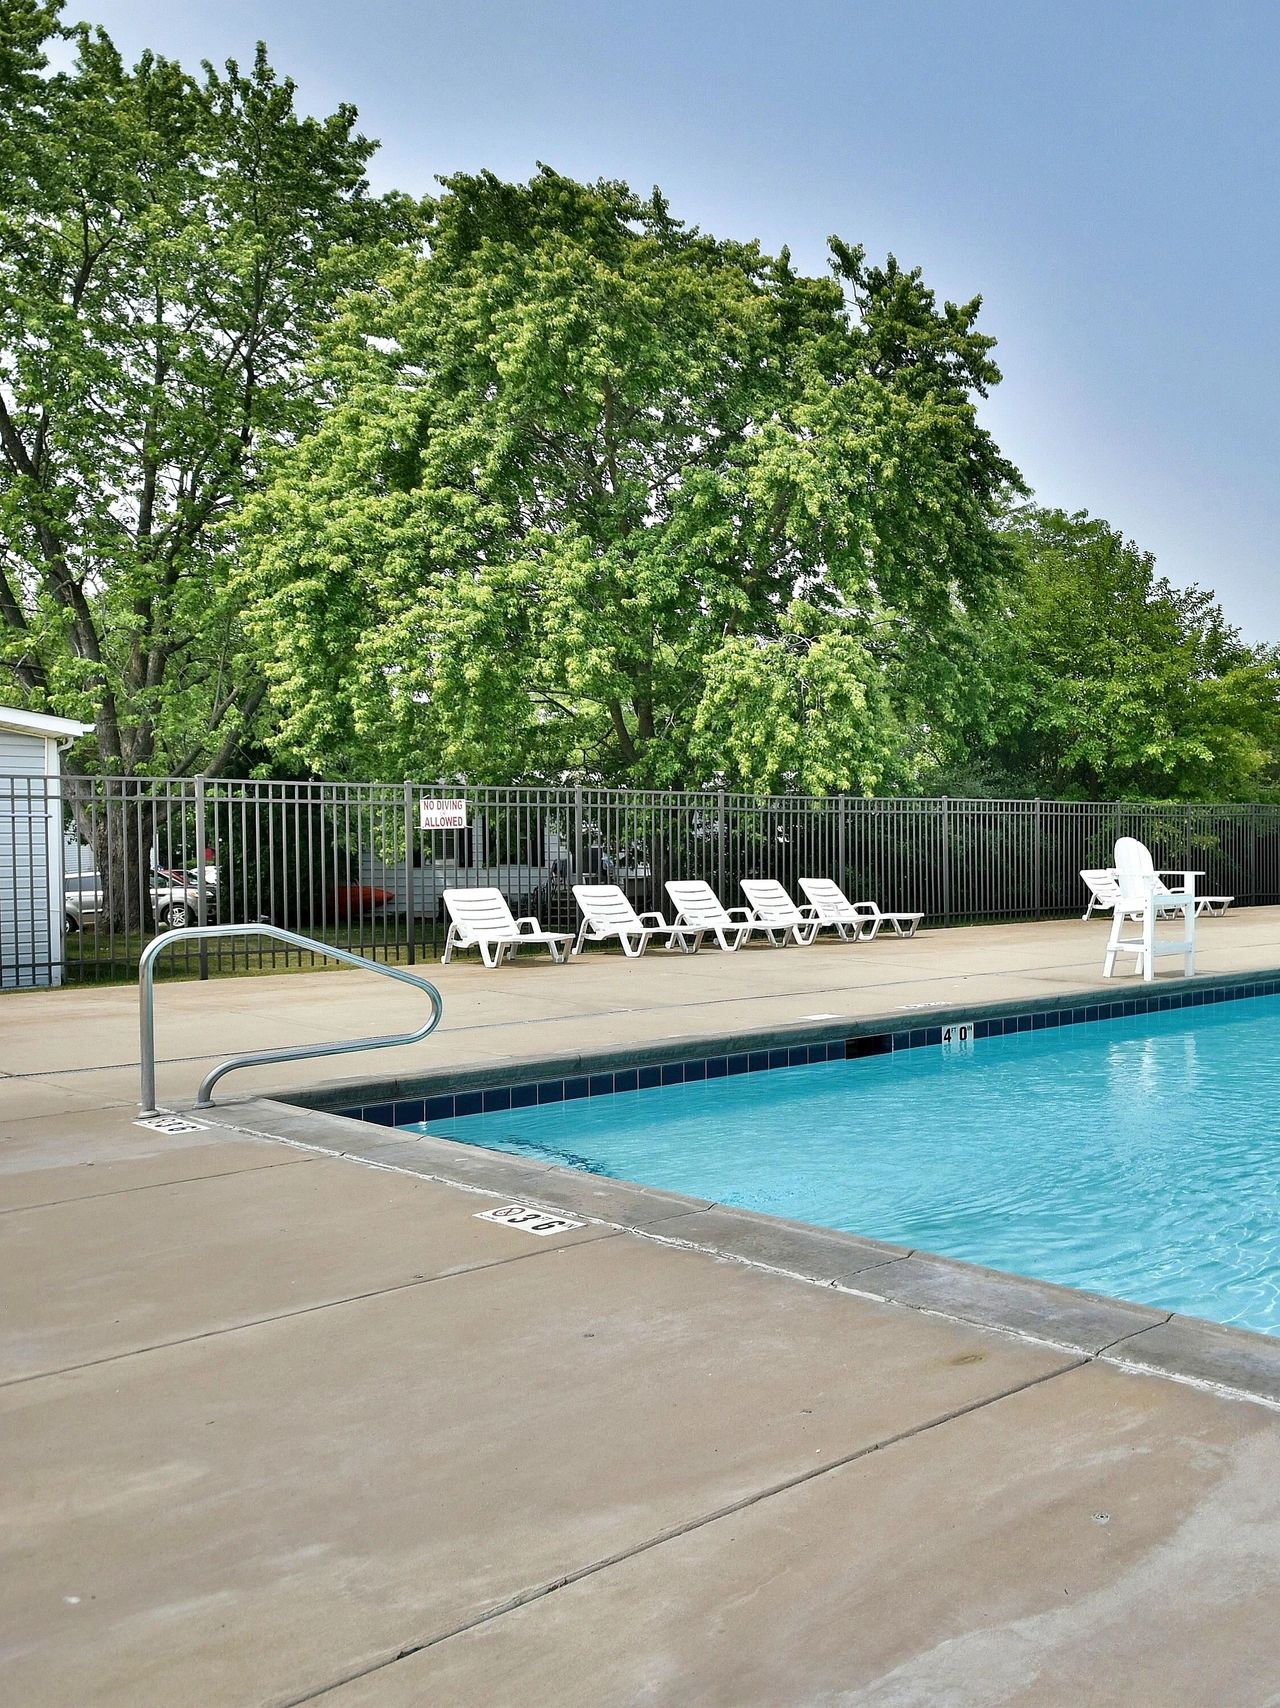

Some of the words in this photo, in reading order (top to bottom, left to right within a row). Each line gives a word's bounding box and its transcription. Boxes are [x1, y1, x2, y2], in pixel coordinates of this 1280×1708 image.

[423, 800, 435, 810] NO
[436, 800, 463, 810] DIVING
[424, 816, 463, 827] ALLOWED
[943, 1027, 952, 1043] 4
[959, 1026, 967, 1041] 0
[507, 1213, 542, 1223] 3
[531, 1220, 566, 1231] 6
